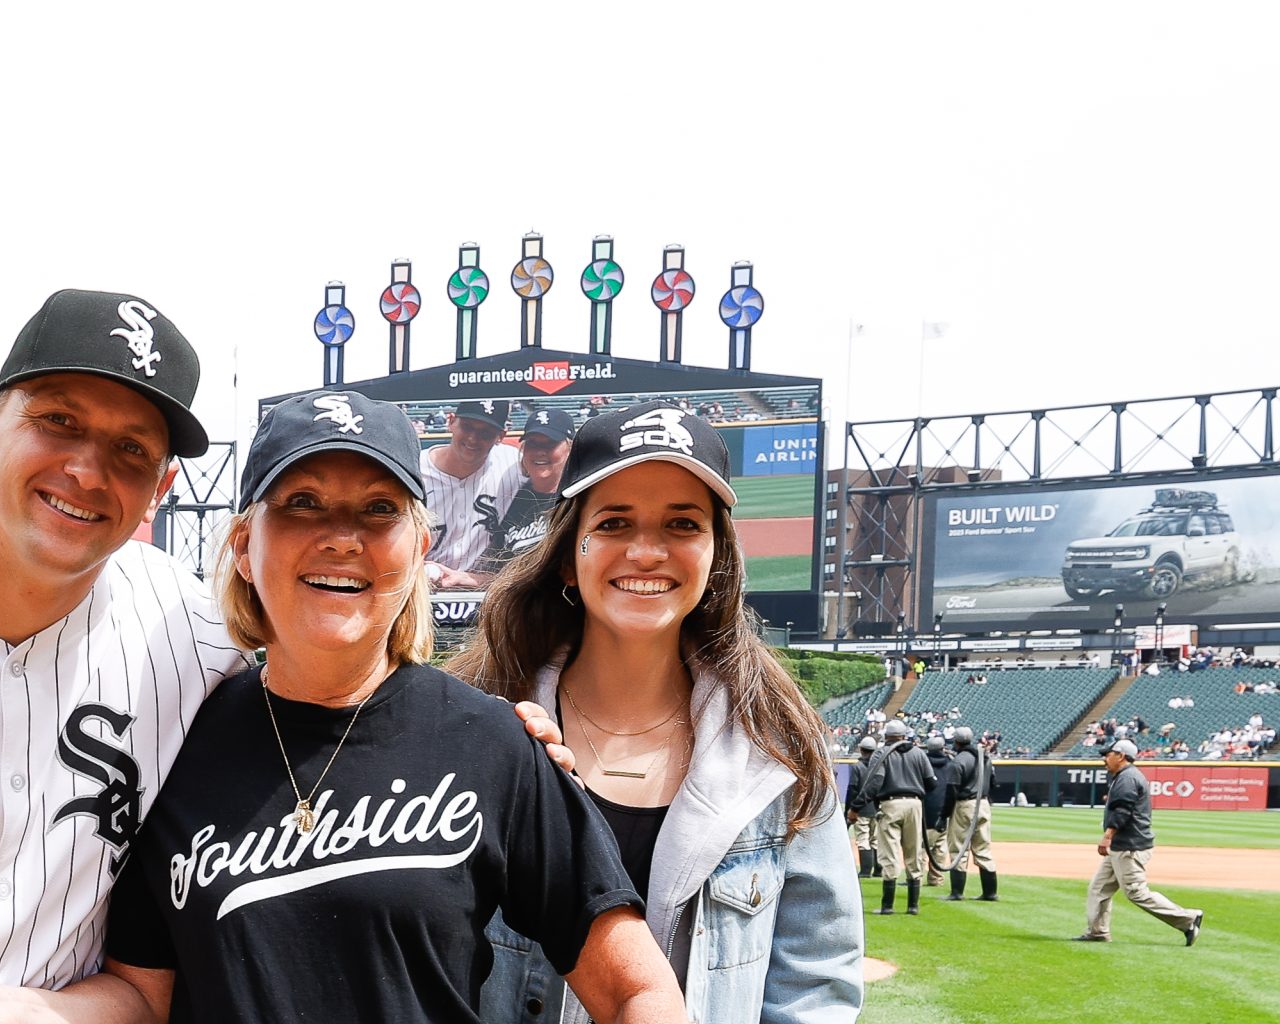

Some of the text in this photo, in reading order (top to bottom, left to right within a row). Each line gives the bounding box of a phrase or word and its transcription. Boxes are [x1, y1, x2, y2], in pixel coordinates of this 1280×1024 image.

[448, 366, 532, 388] guaranteed
[533, 365, 567, 382] Rate
[773, 437, 818, 450] UNIT
[755, 450, 818, 464] AIRLIN
[948, 507, 1002, 526] BUILT
[946, 595, 977, 609] Ford
[1067, 768, 1108, 784] THE
[1149, 780, 1175, 796] BC
[170, 772, 483, 910] Southside
